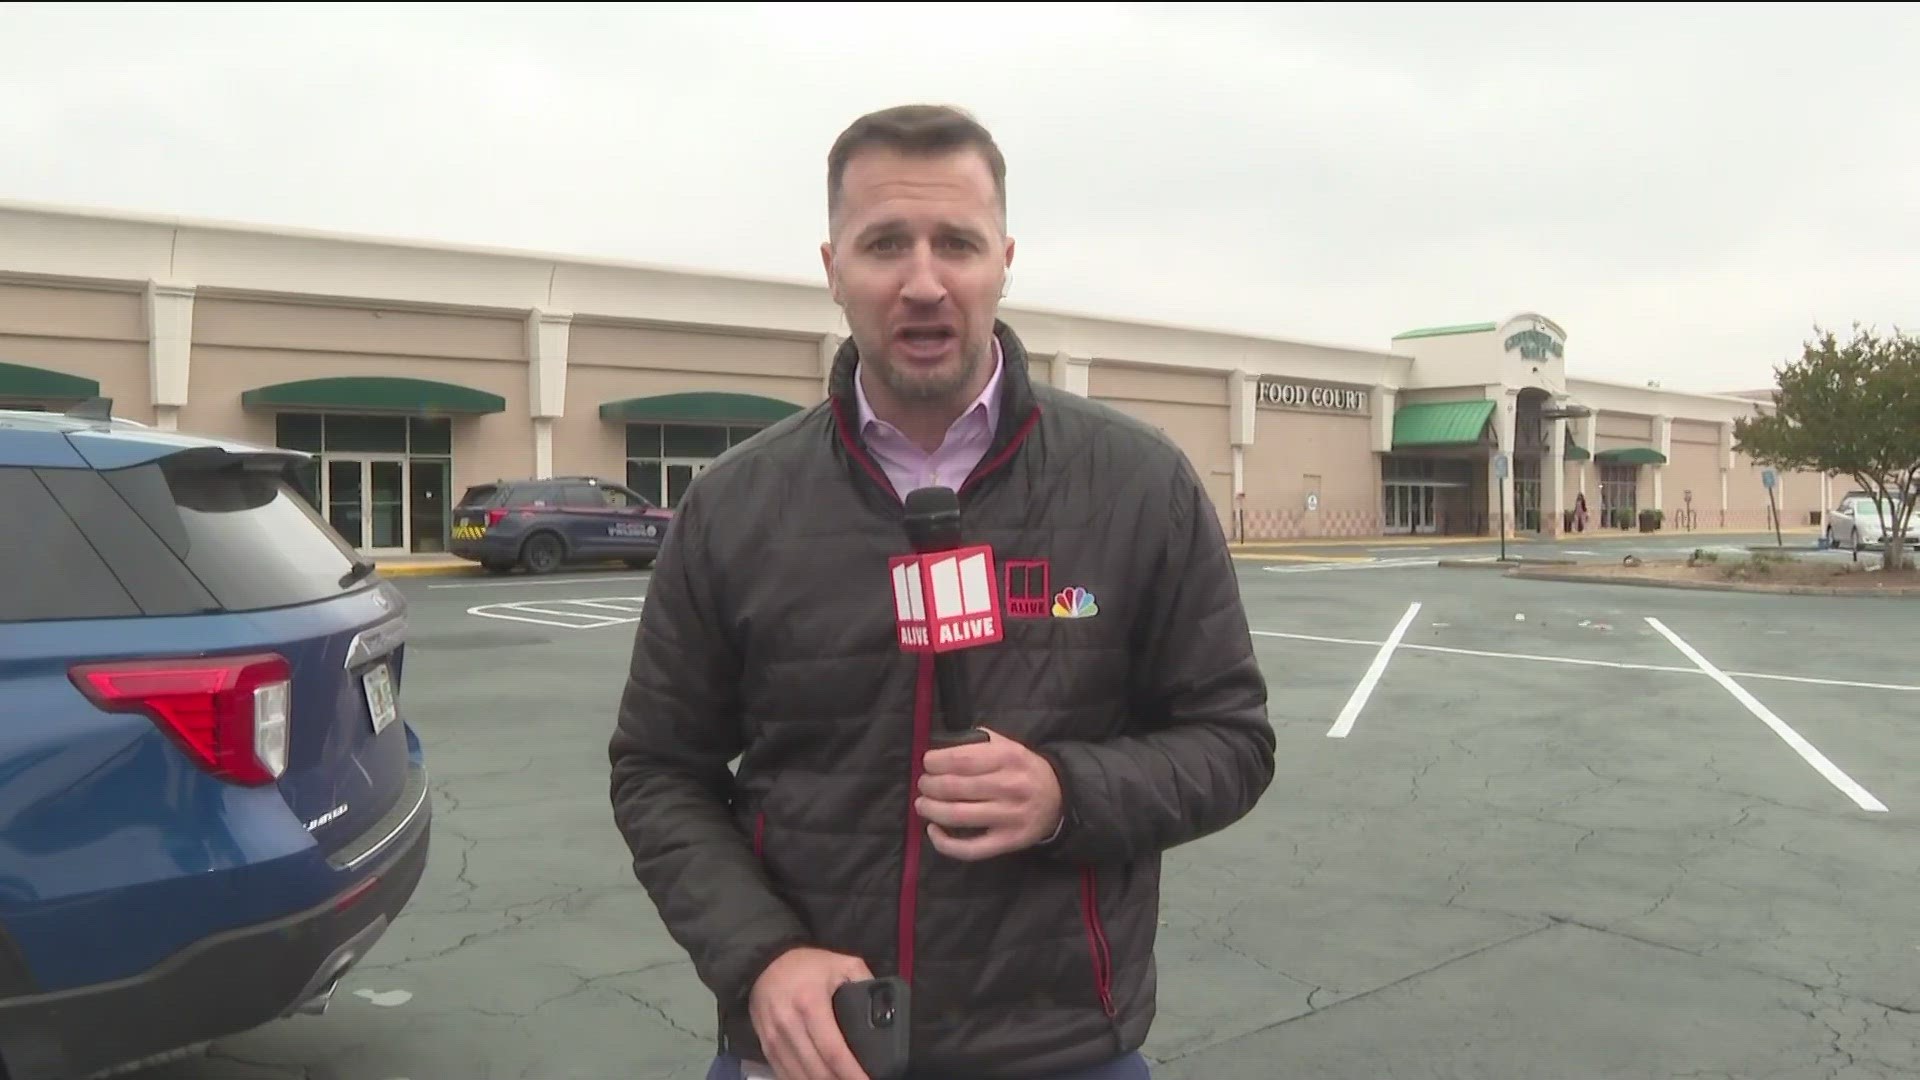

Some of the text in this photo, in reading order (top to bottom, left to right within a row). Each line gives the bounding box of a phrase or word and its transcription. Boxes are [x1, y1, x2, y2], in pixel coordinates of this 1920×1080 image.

[1258, 382, 1367, 409] FOOD COURT
[1010, 602, 1045, 614] ALIVE
[901, 626, 929, 646] ALIVE
[939, 617, 995, 644] ALIVE
